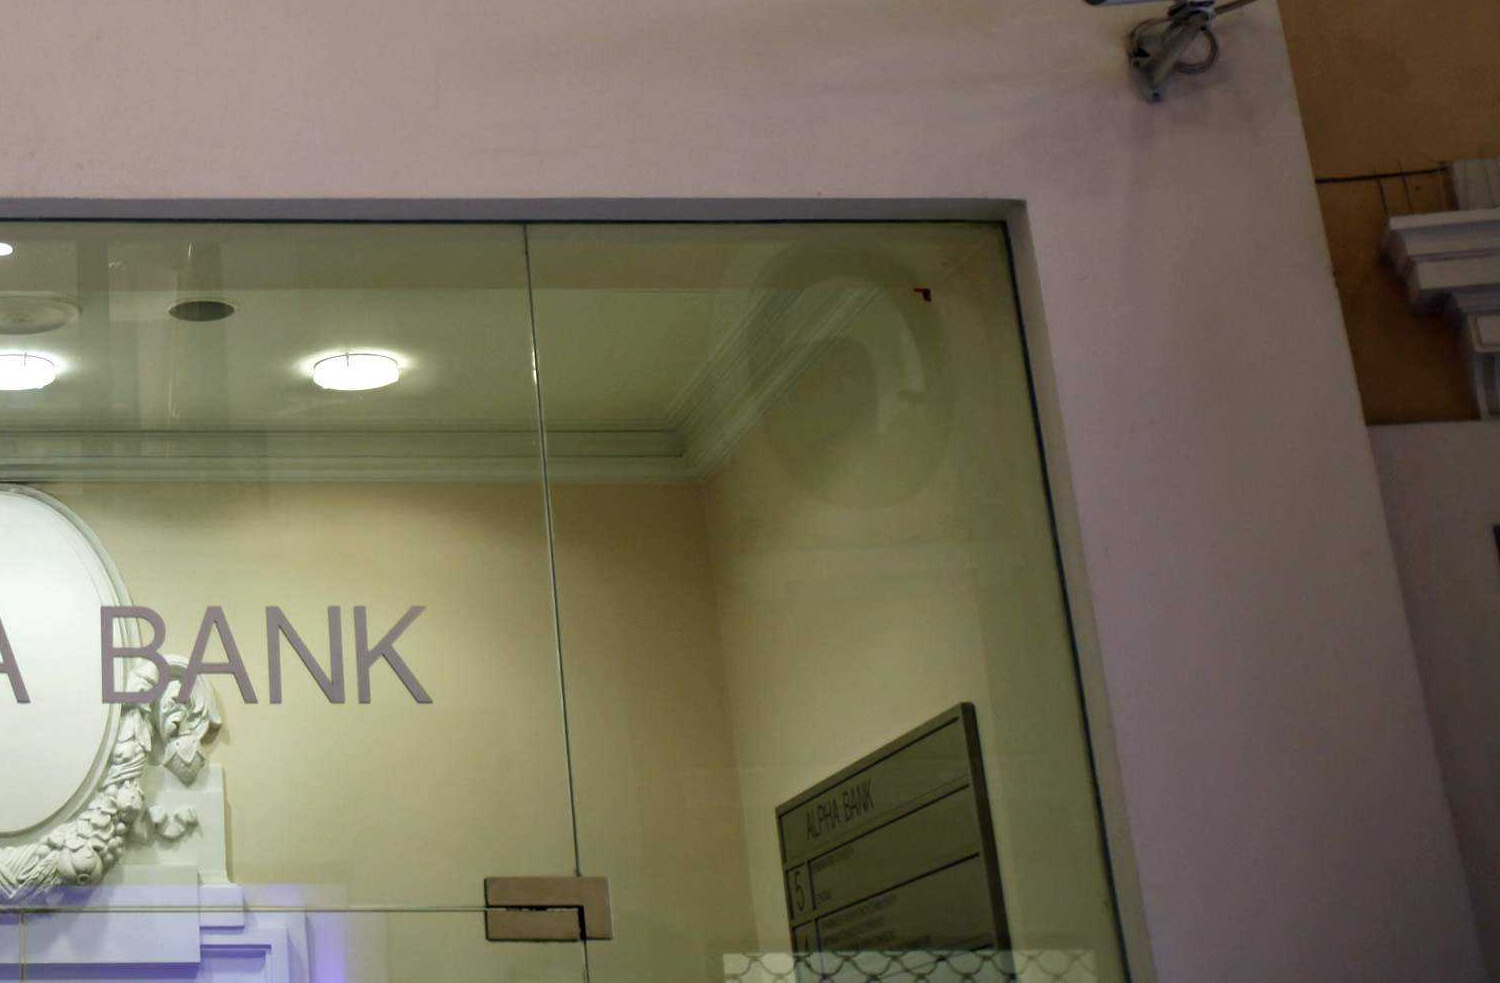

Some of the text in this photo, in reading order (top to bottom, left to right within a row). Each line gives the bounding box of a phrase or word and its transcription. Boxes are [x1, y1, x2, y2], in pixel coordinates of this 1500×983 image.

[100, 605, 433, 705] BANK
[806, 779, 875, 840] ALPHA BANK
[794, 870, 805, 912] 5
